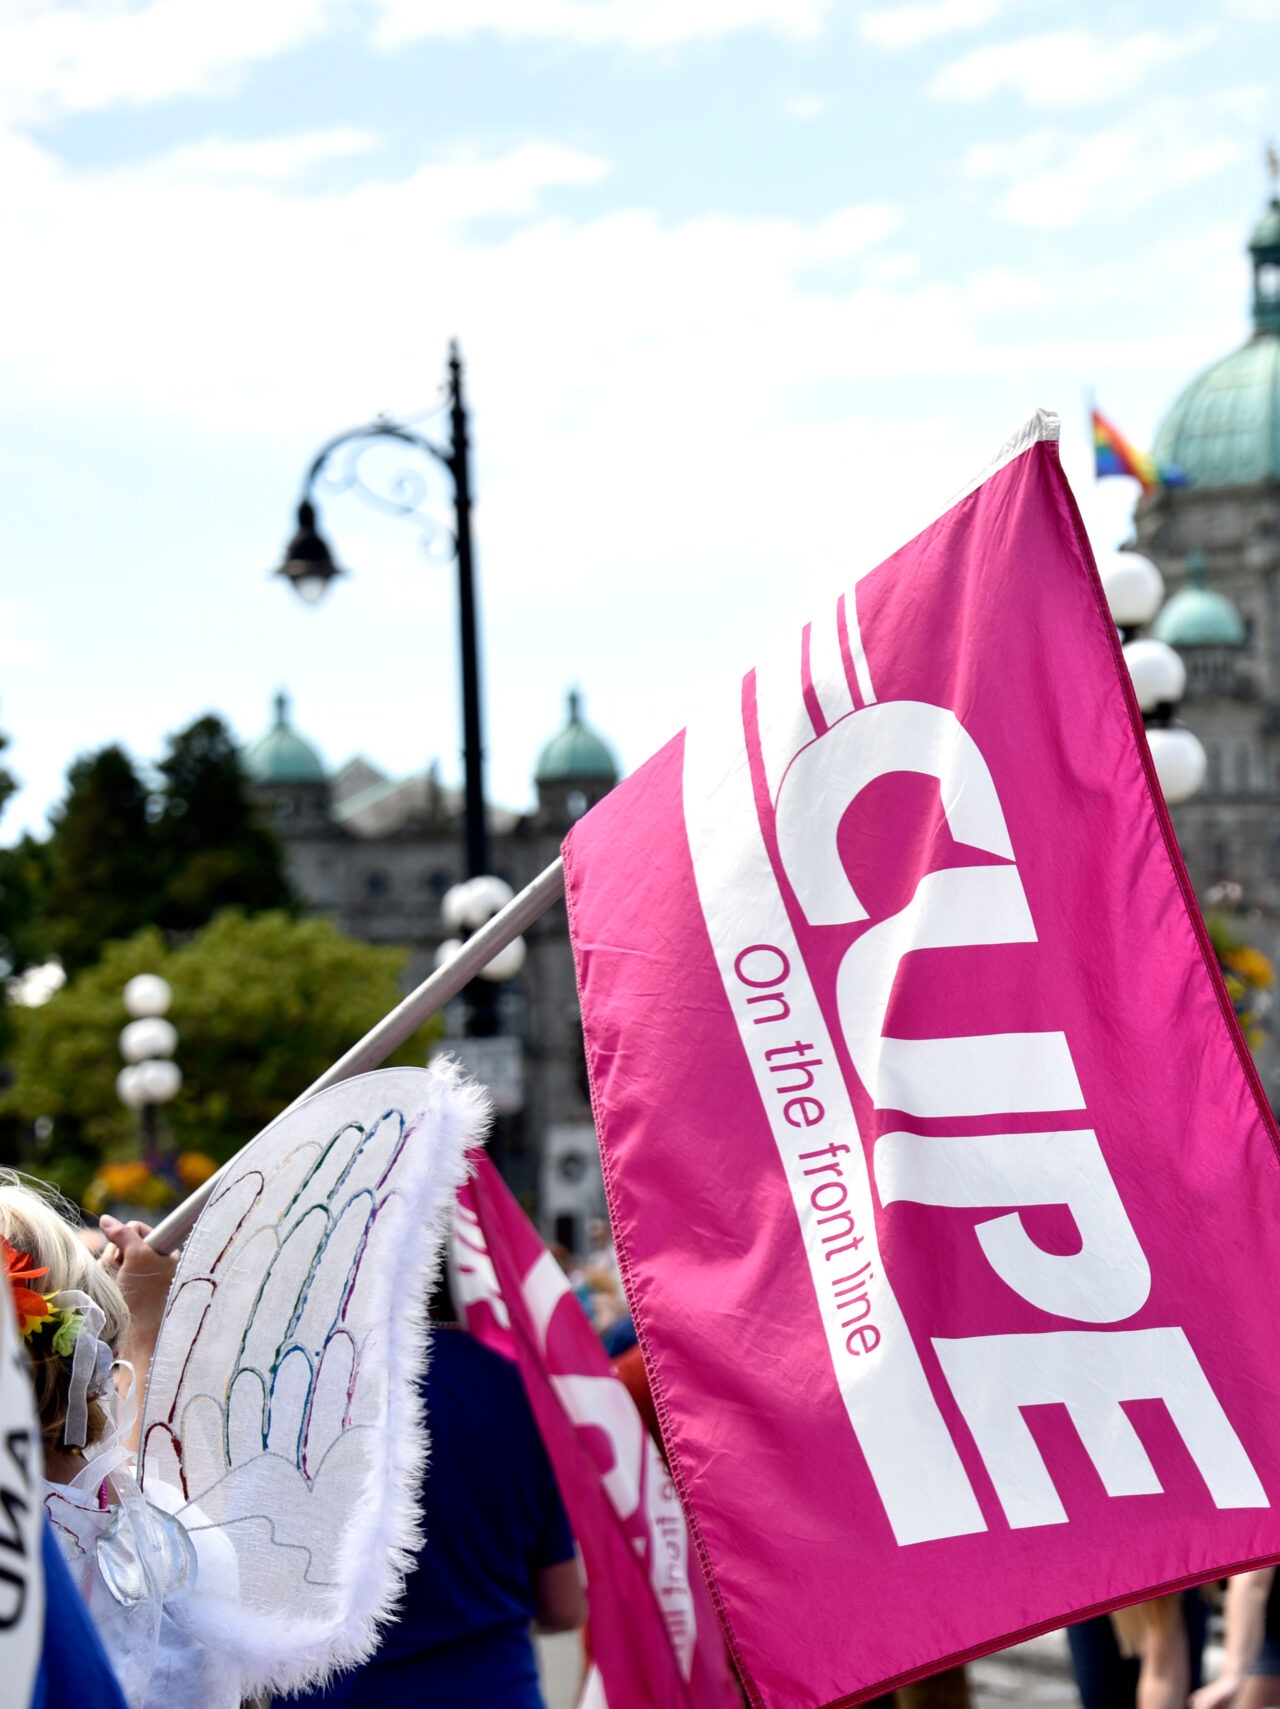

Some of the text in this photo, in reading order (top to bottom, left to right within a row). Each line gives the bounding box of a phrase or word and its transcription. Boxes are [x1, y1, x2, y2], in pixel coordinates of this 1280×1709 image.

[734, 943, 881, 1357] On the front line
[774, 699, 1270, 1530] CUPE
